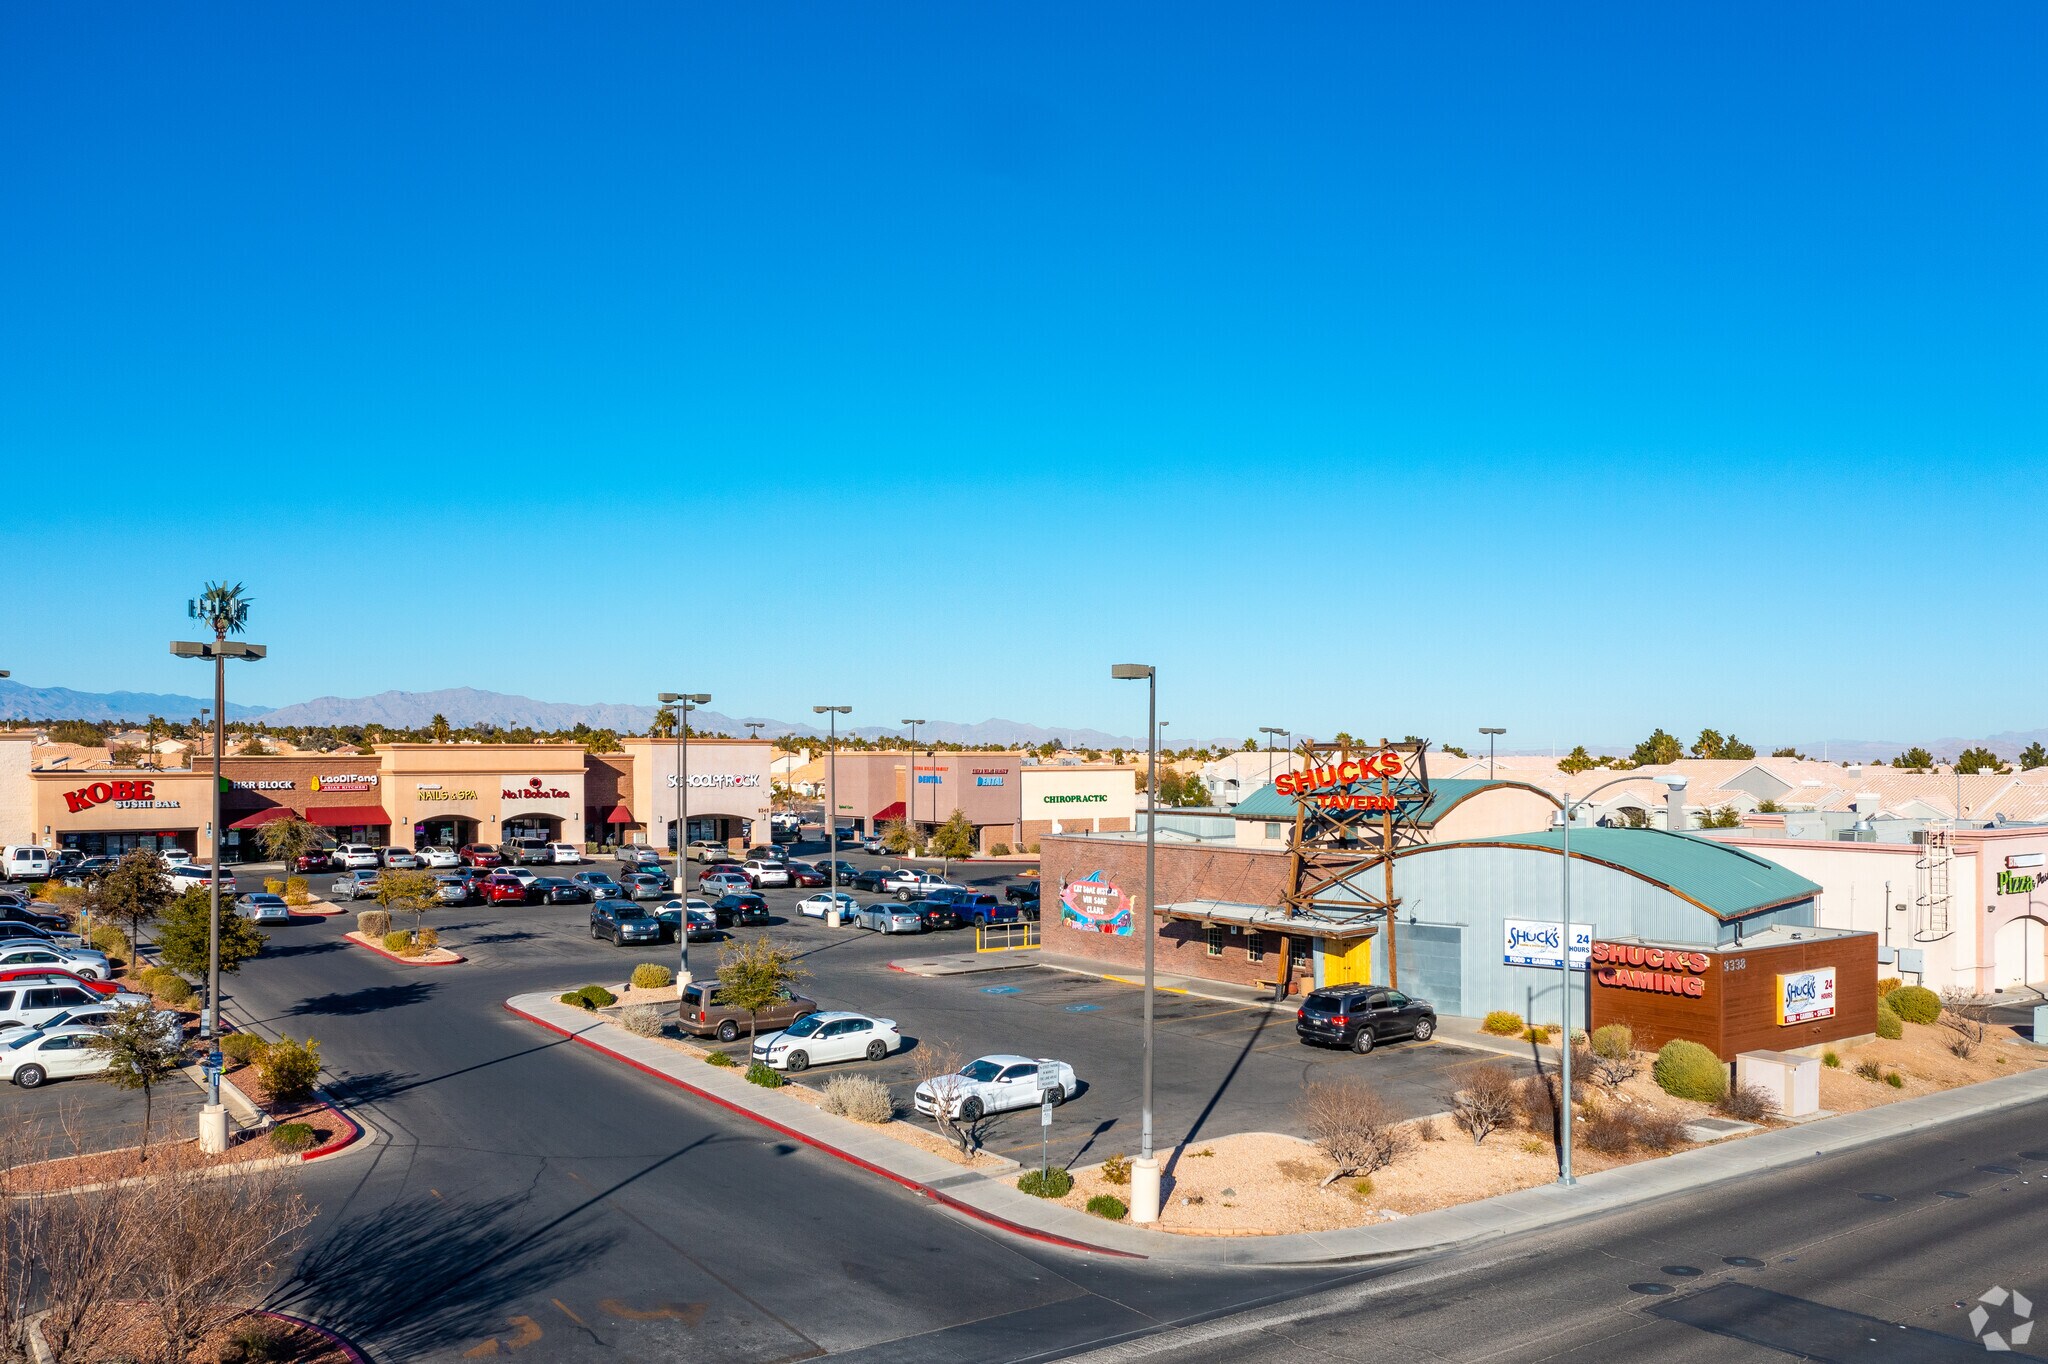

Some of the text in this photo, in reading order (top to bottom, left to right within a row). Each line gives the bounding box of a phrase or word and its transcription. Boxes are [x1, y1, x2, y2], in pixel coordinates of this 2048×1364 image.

[918, 775, 942, 784] DENTAL
[1275, 753, 1402, 796] SHUCKS
[233, 781, 293, 790] H&R BLOCK
[977, 776, 1004, 786] DENTAL
[63, 780, 155, 813] KOBE
[418, 790, 449, 801] NAILS
[458, 790, 477, 800] SPA
[523, 788, 551, 798] Boba
[549, 788, 570, 798] Tea
[1043, 795, 1108, 803] CHIROPRACTIC
[1316, 795, 1396, 810] TAVERN
[115, 801, 180, 809] SUSHI BAR
[1998, 870, 2033, 894] Pizza
[1073, 885, 1082, 893] EAT
[1096, 887, 1118, 897] OYSTRS
[1094, 897, 1107, 905] SOME
[1086, 906, 1104, 914] CLAMS
[1576, 934, 1590, 944] 24
[1569, 946, 1590, 954] HOURS
[1531, 957, 1556, 966] GAMING
[1592, 942, 1708, 974] SHUCK'S
[1598, 967, 1704, 997] GAMING
[1825, 979, 1833, 990] 24
[1786, 1014, 1796, 1022] FOOD
